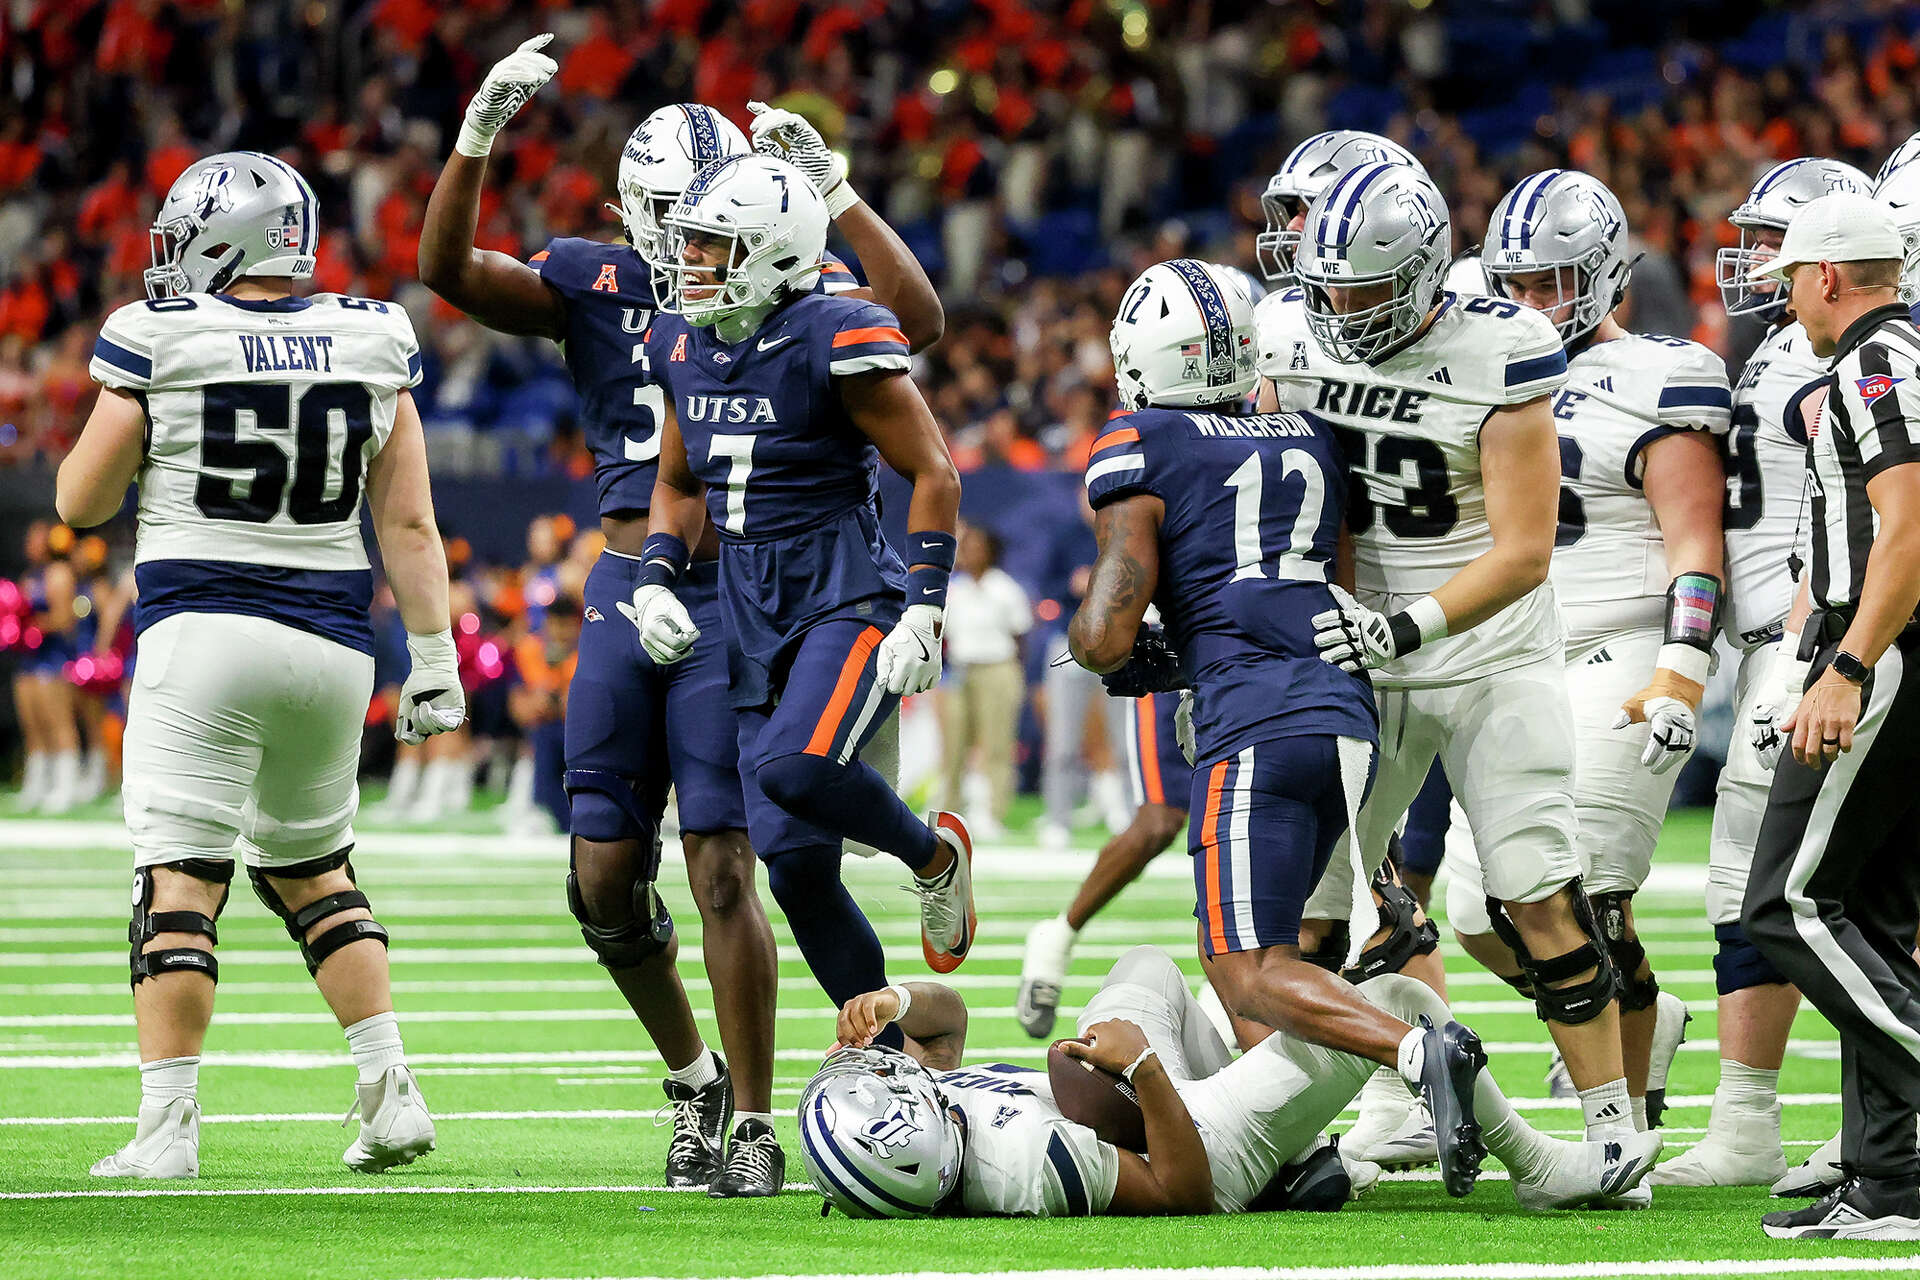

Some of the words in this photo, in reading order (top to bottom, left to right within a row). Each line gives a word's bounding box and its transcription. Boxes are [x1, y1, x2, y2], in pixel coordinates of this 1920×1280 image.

[772, 175, 789, 213] 7
[1321, 261, 1340, 275] WE
[1505, 251, 1522, 263] WE
[592, 264, 619, 293] A
[1121, 285, 1151, 325] 12
[238, 335, 333, 373] VALENT
[670, 333, 688, 362] A
[1289, 341, 1309, 370] A
[1315, 377, 1431, 425] RICE
[1866, 382, 1886, 396] CFO
[686, 395, 778, 423] UTSA
[1183, 412, 1315, 438] WILKERSON
[193, 383, 375, 525] 50
[707, 433, 757, 538] 7
[1805, 467, 1823, 498] R
[1223, 448, 1332, 584] 12
